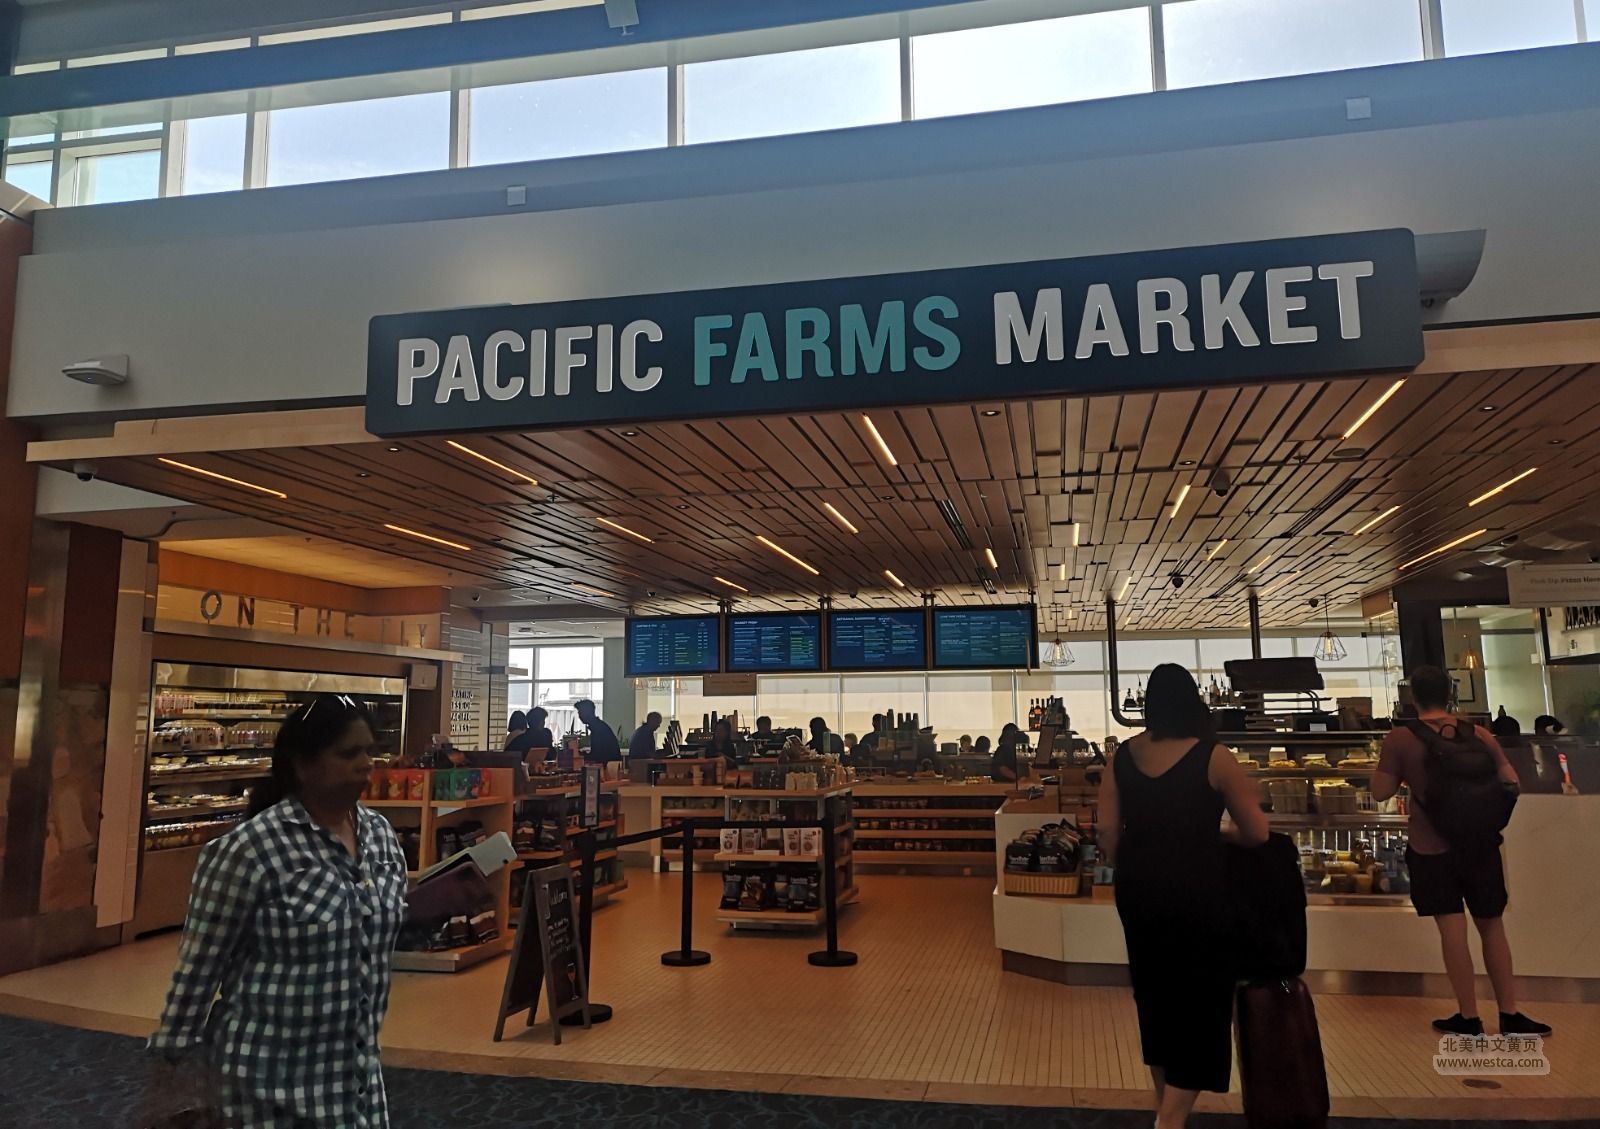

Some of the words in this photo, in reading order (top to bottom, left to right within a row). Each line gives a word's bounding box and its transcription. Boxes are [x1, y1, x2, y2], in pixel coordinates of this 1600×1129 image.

[397, 319, 664, 407] PACIFIC
[693, 295, 962, 387] FARMS
[993, 260, 1375, 366] MARKET
[201, 591, 255, 627] ON
[289, 604, 355, 638] THE
